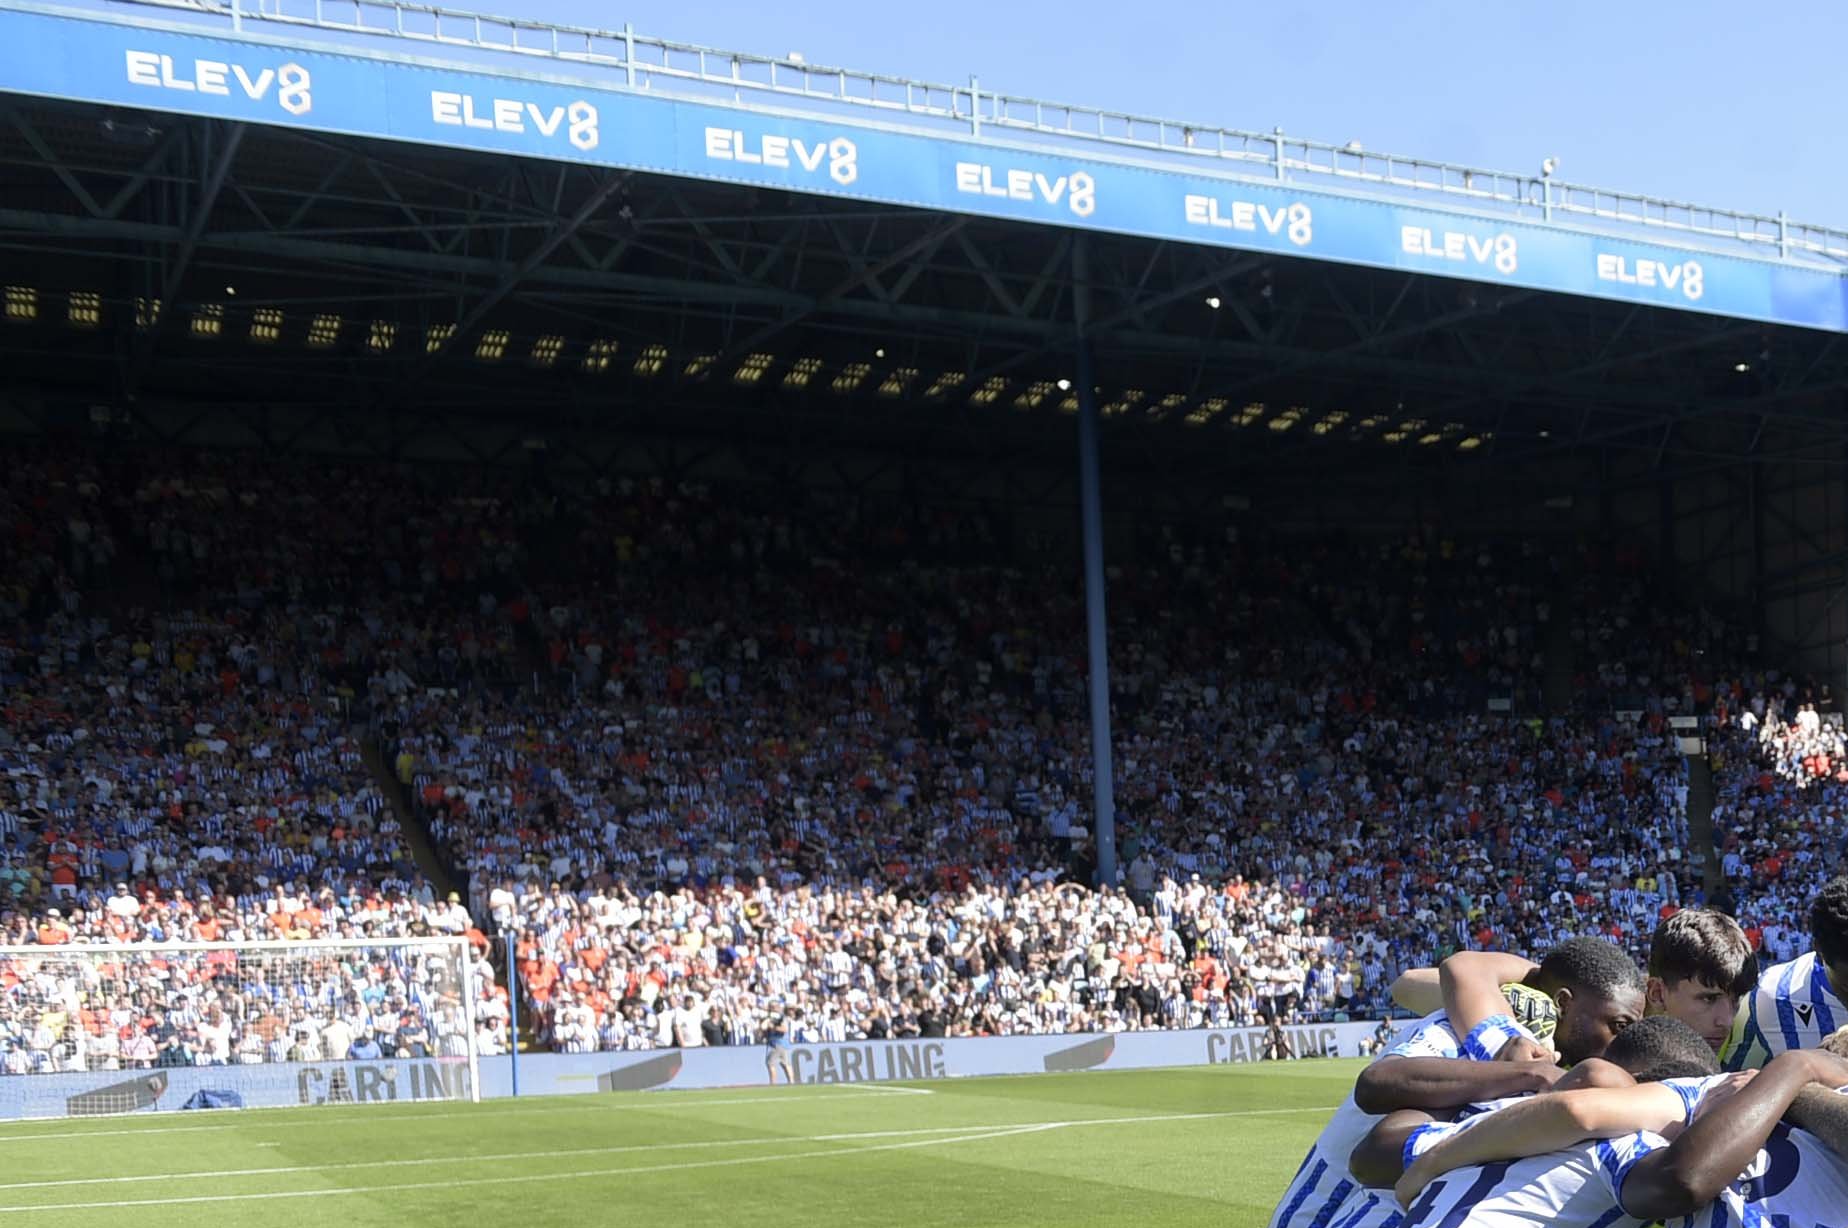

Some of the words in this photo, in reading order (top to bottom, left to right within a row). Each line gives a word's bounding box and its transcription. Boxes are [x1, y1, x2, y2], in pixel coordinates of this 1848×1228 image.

[125, 49, 312, 115] ELEV8
[430, 90, 599, 152] ELEV8
[704, 126, 857, 186] ELEV8
[955, 161, 1095, 217] ELEV8
[1185, 195, 1312, 247] ELEV8
[1401, 225, 1517, 274] ELEV8
[1597, 253, 1703, 300] ELEV8
[791, 1043, 945, 1084] CARLING
[1207, 1028, 1338, 1064] CARING
